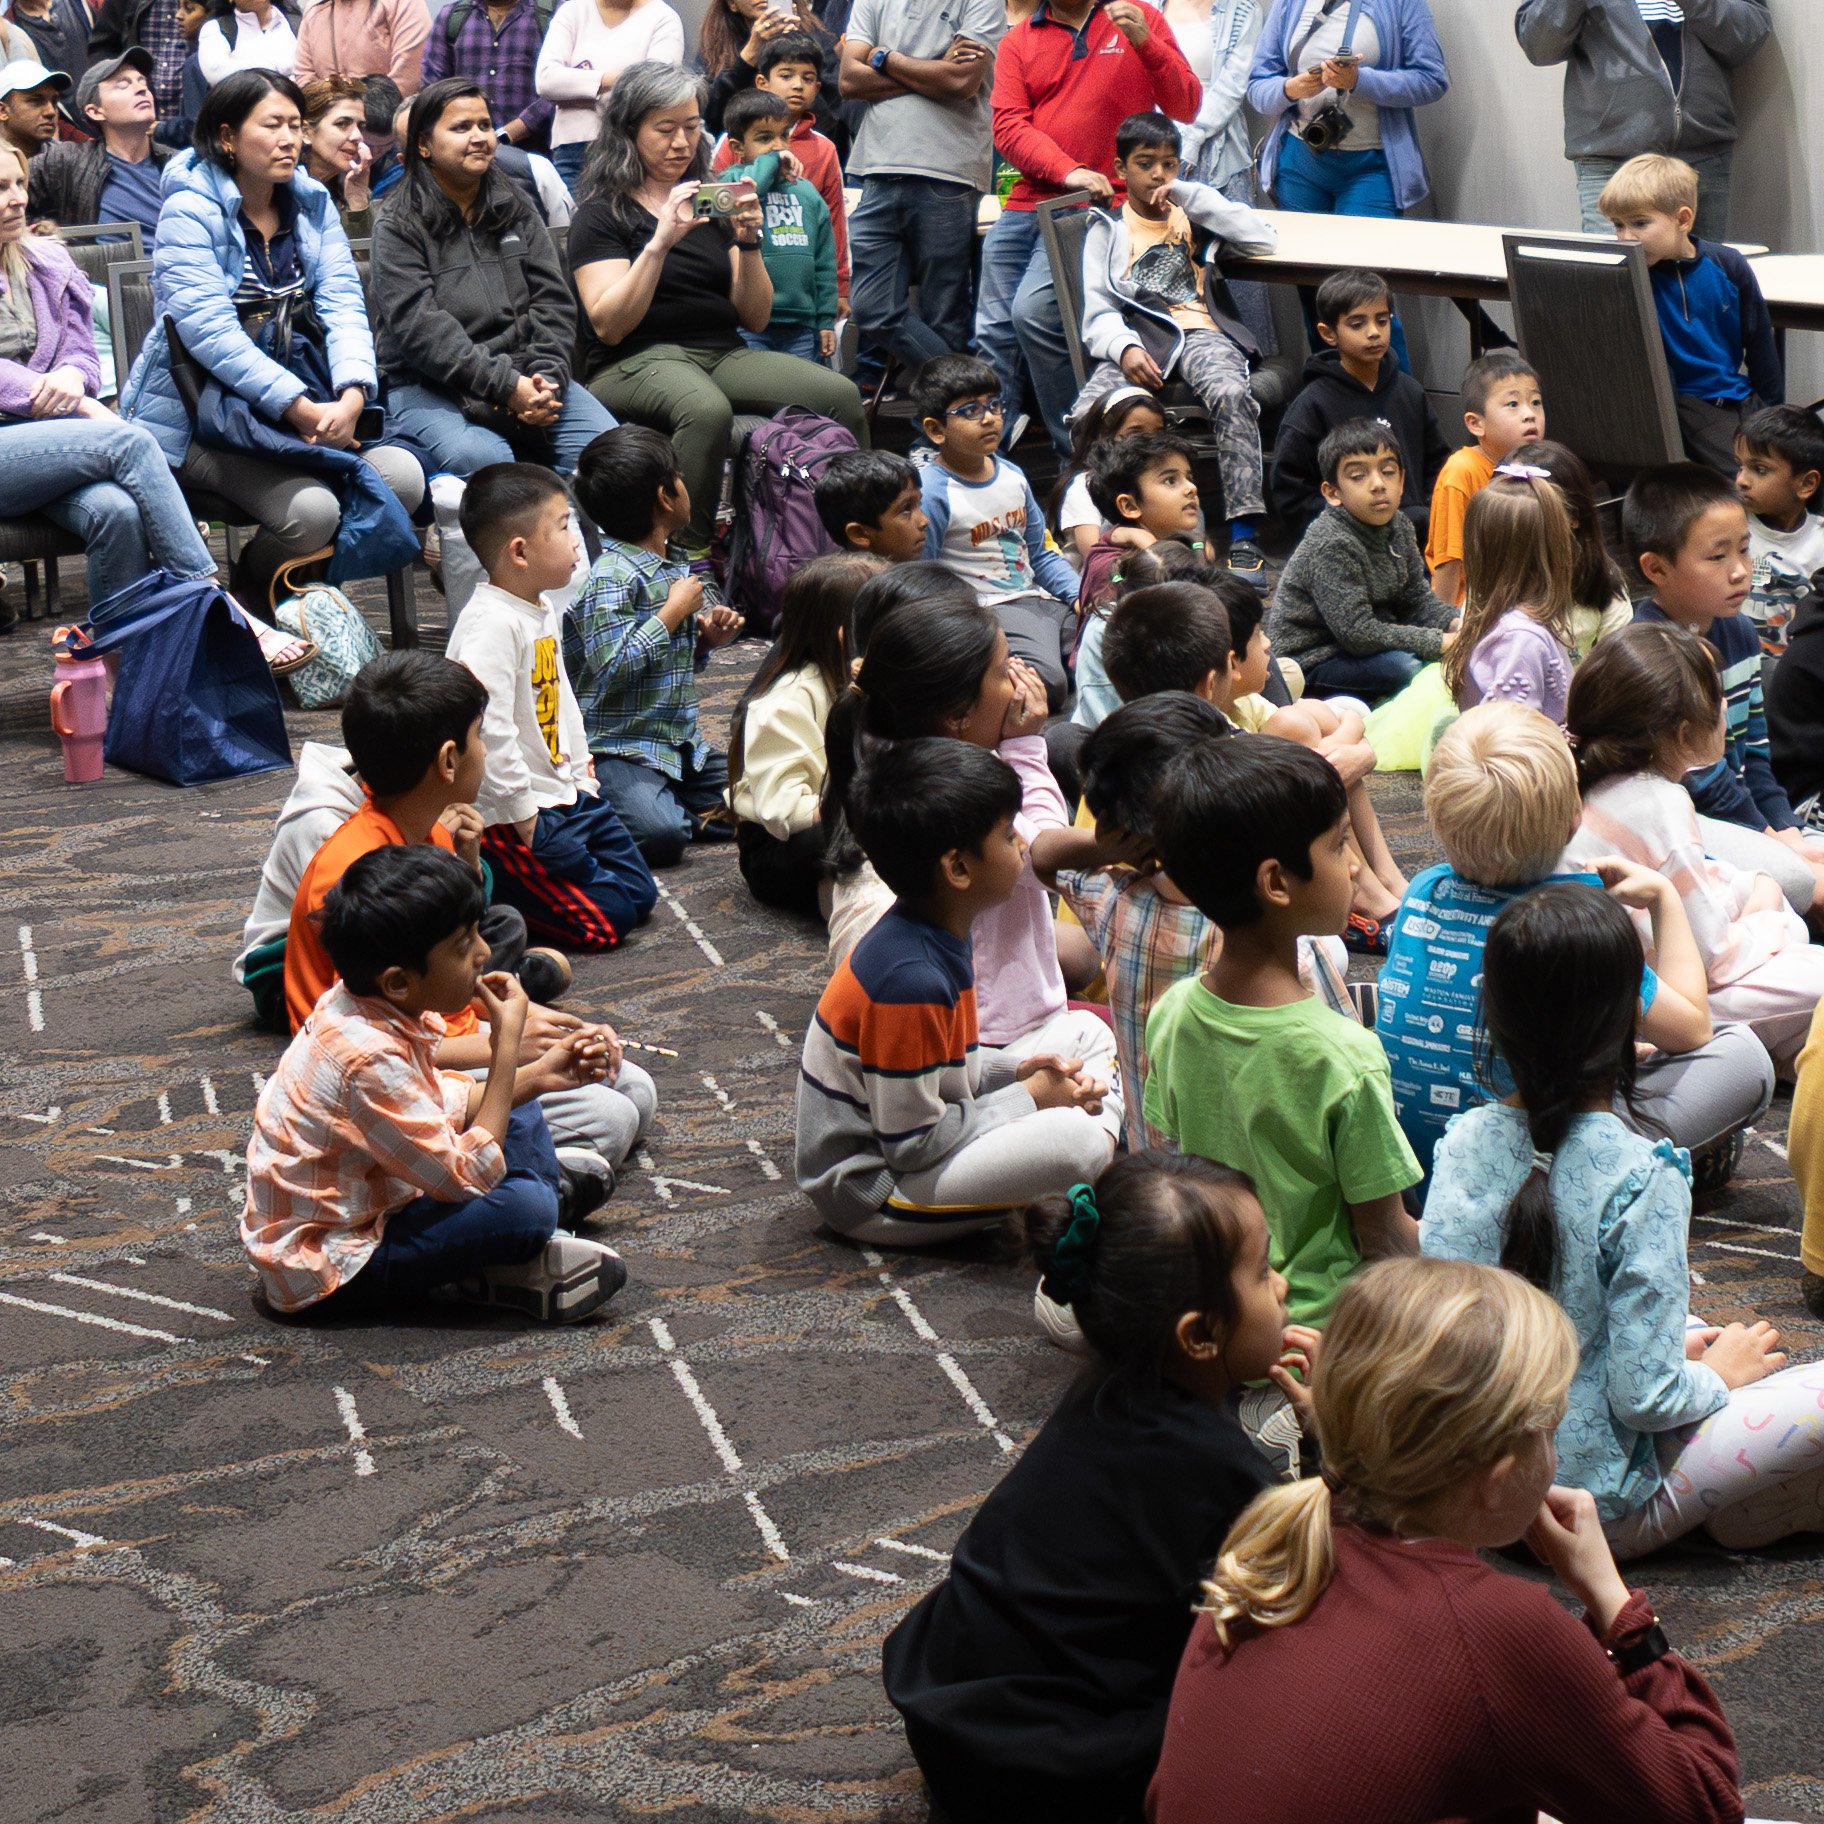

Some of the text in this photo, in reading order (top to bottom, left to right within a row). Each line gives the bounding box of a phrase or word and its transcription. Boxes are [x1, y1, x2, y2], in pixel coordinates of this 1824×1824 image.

[767, 192, 800, 206] JUST A
[771, 233, 810, 247] SOCCER
